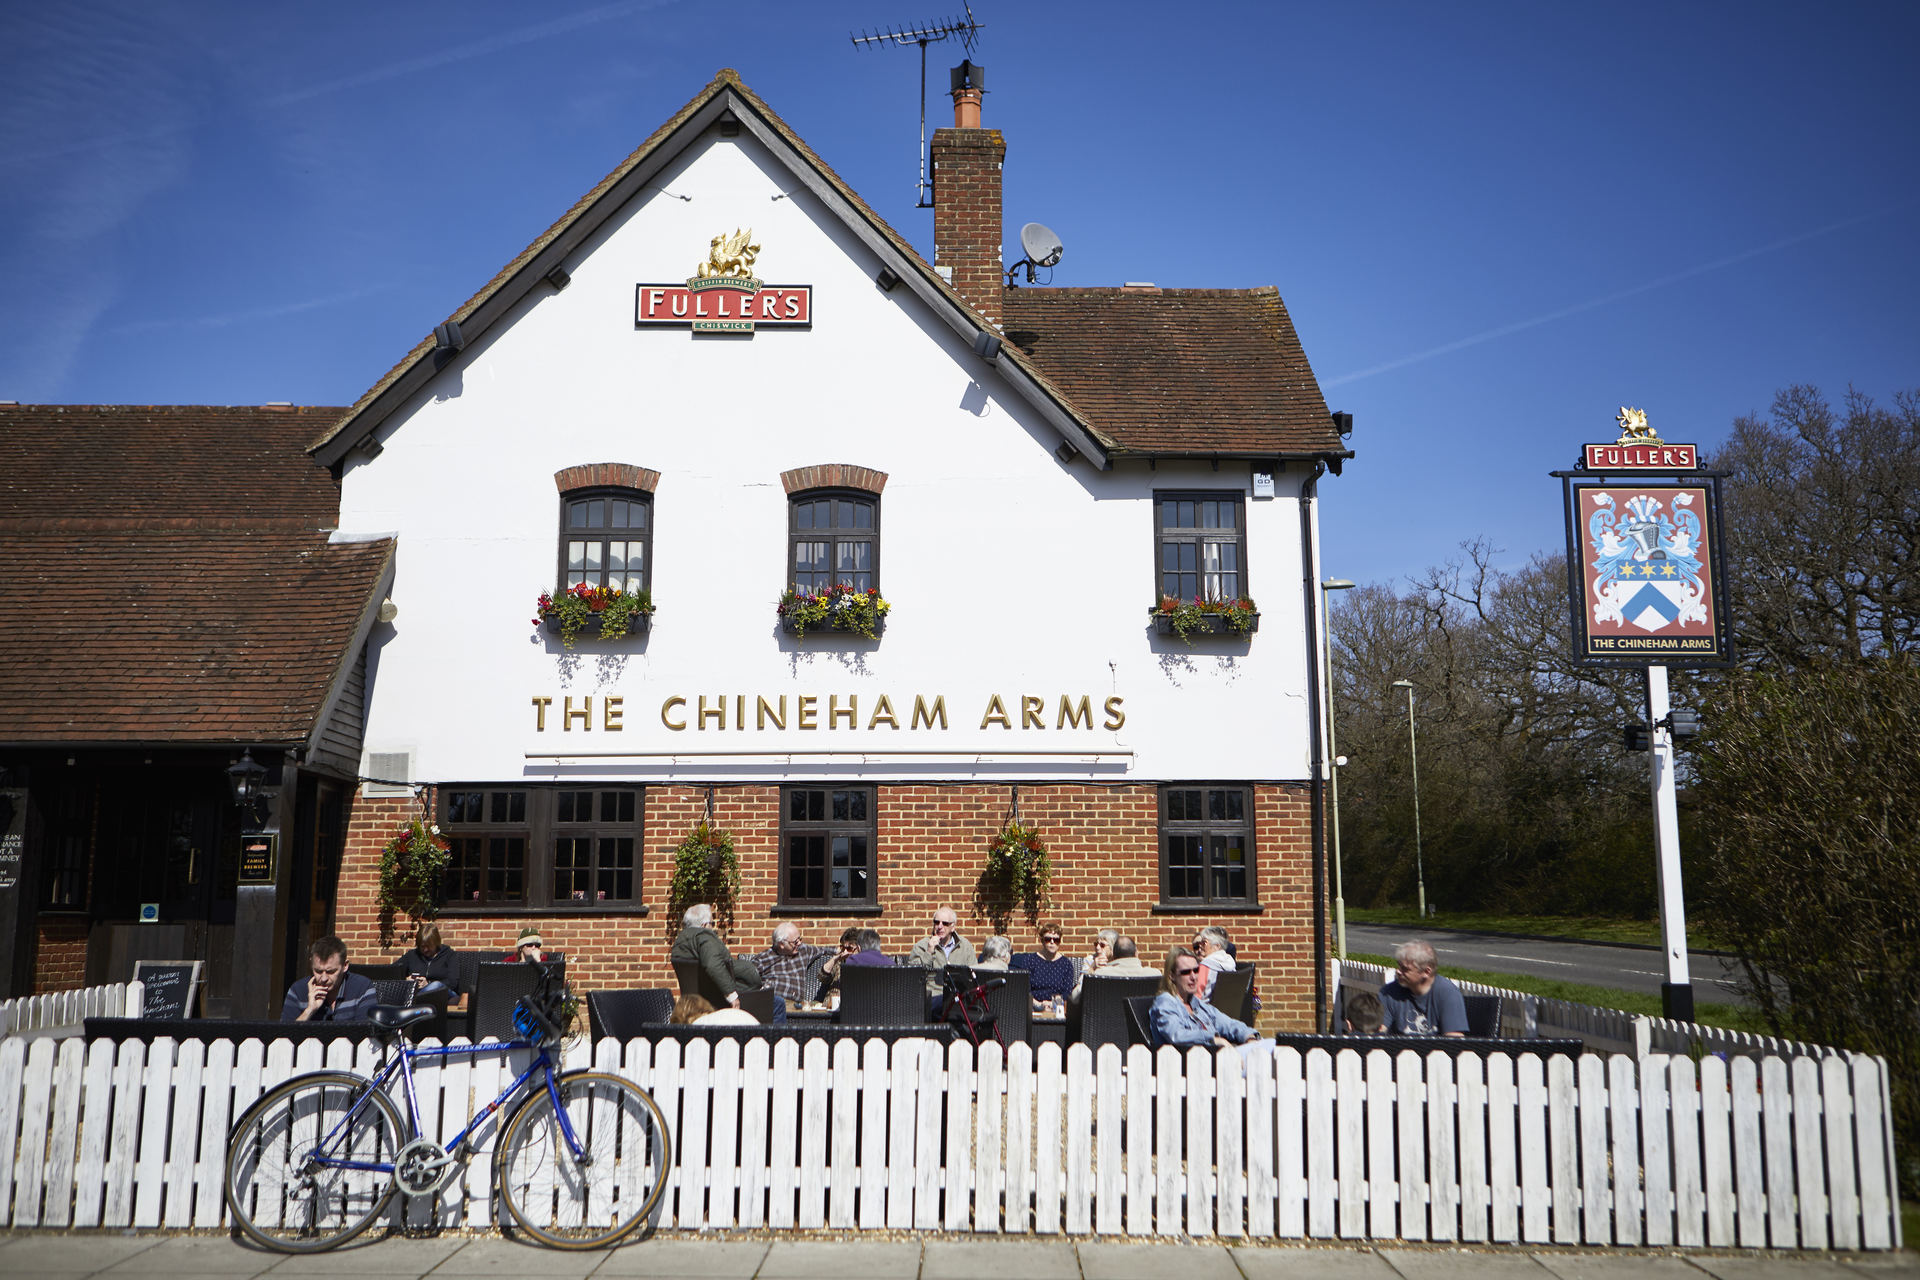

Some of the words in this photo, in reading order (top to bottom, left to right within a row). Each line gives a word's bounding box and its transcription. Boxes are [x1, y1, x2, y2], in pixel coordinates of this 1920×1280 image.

[648, 290, 799, 319] FULLER'S
[1593, 447, 1690, 466] FULLER'S
[1593, 638, 1615, 648] THE
[1617, 638, 1678, 648] CHINEHAM
[1681, 639, 1711, 649] ARMS
[531, 695, 624, 731] THE
[661, 694, 949, 731] CHINEHAM
[980, 694, 1126, 731] ARMS
